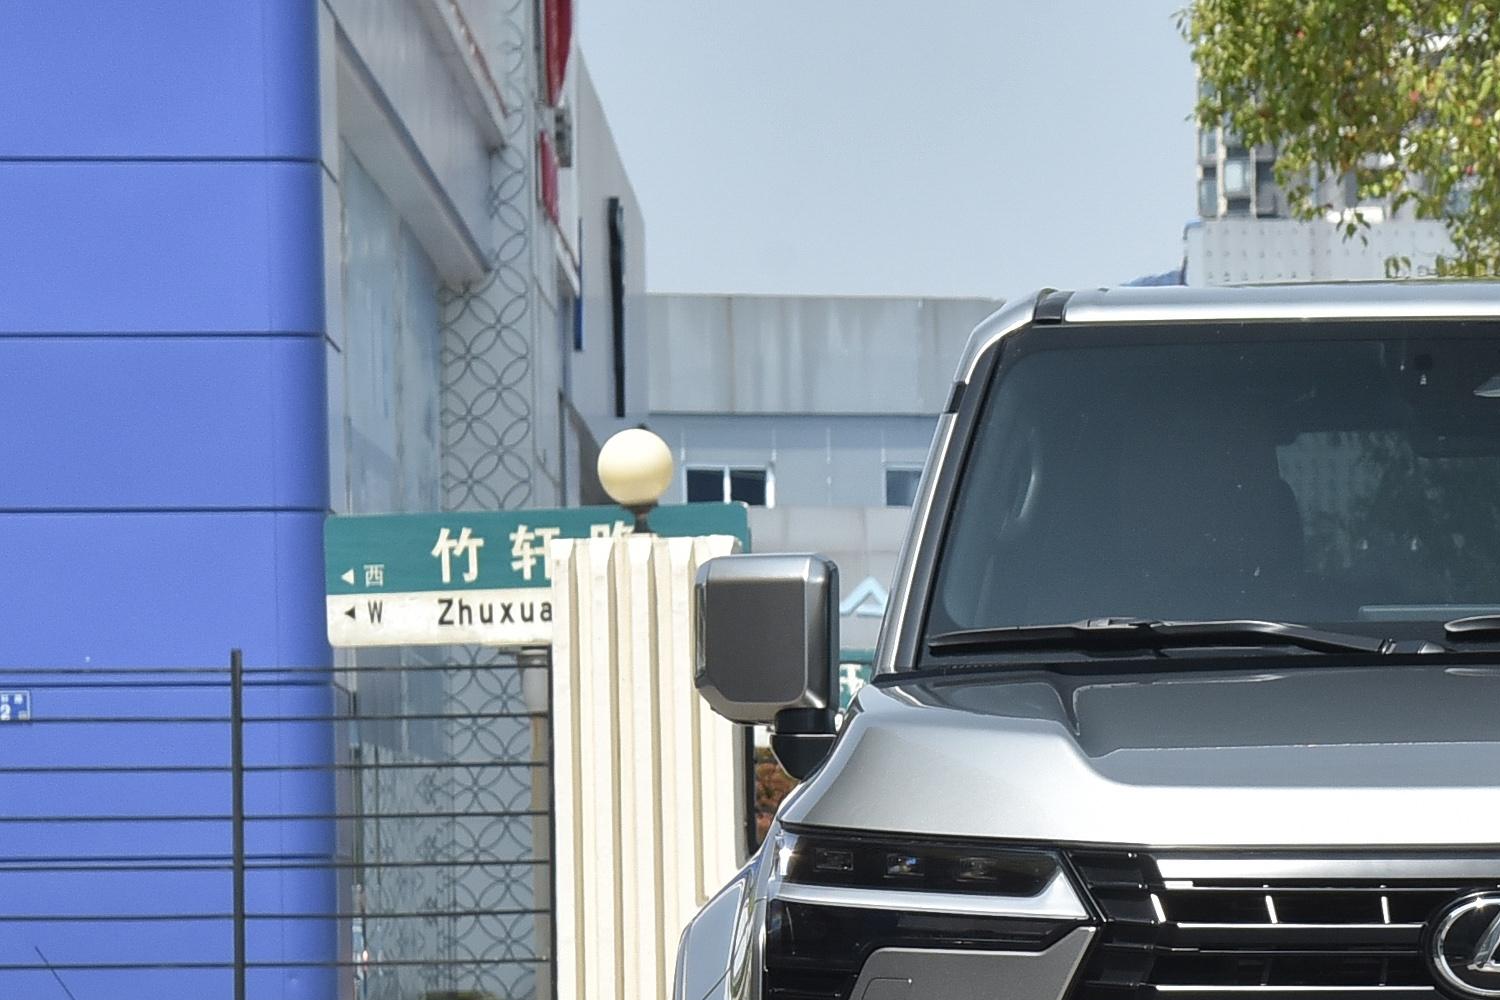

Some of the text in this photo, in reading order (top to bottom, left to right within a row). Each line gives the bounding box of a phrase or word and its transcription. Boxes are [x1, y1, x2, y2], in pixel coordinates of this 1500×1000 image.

[431, 521, 634, 584] 竹轩
[363, 564, 385, 588] 西
[368, 600, 383, 624] W
[437, 597, 553, 626] Zhuxua
